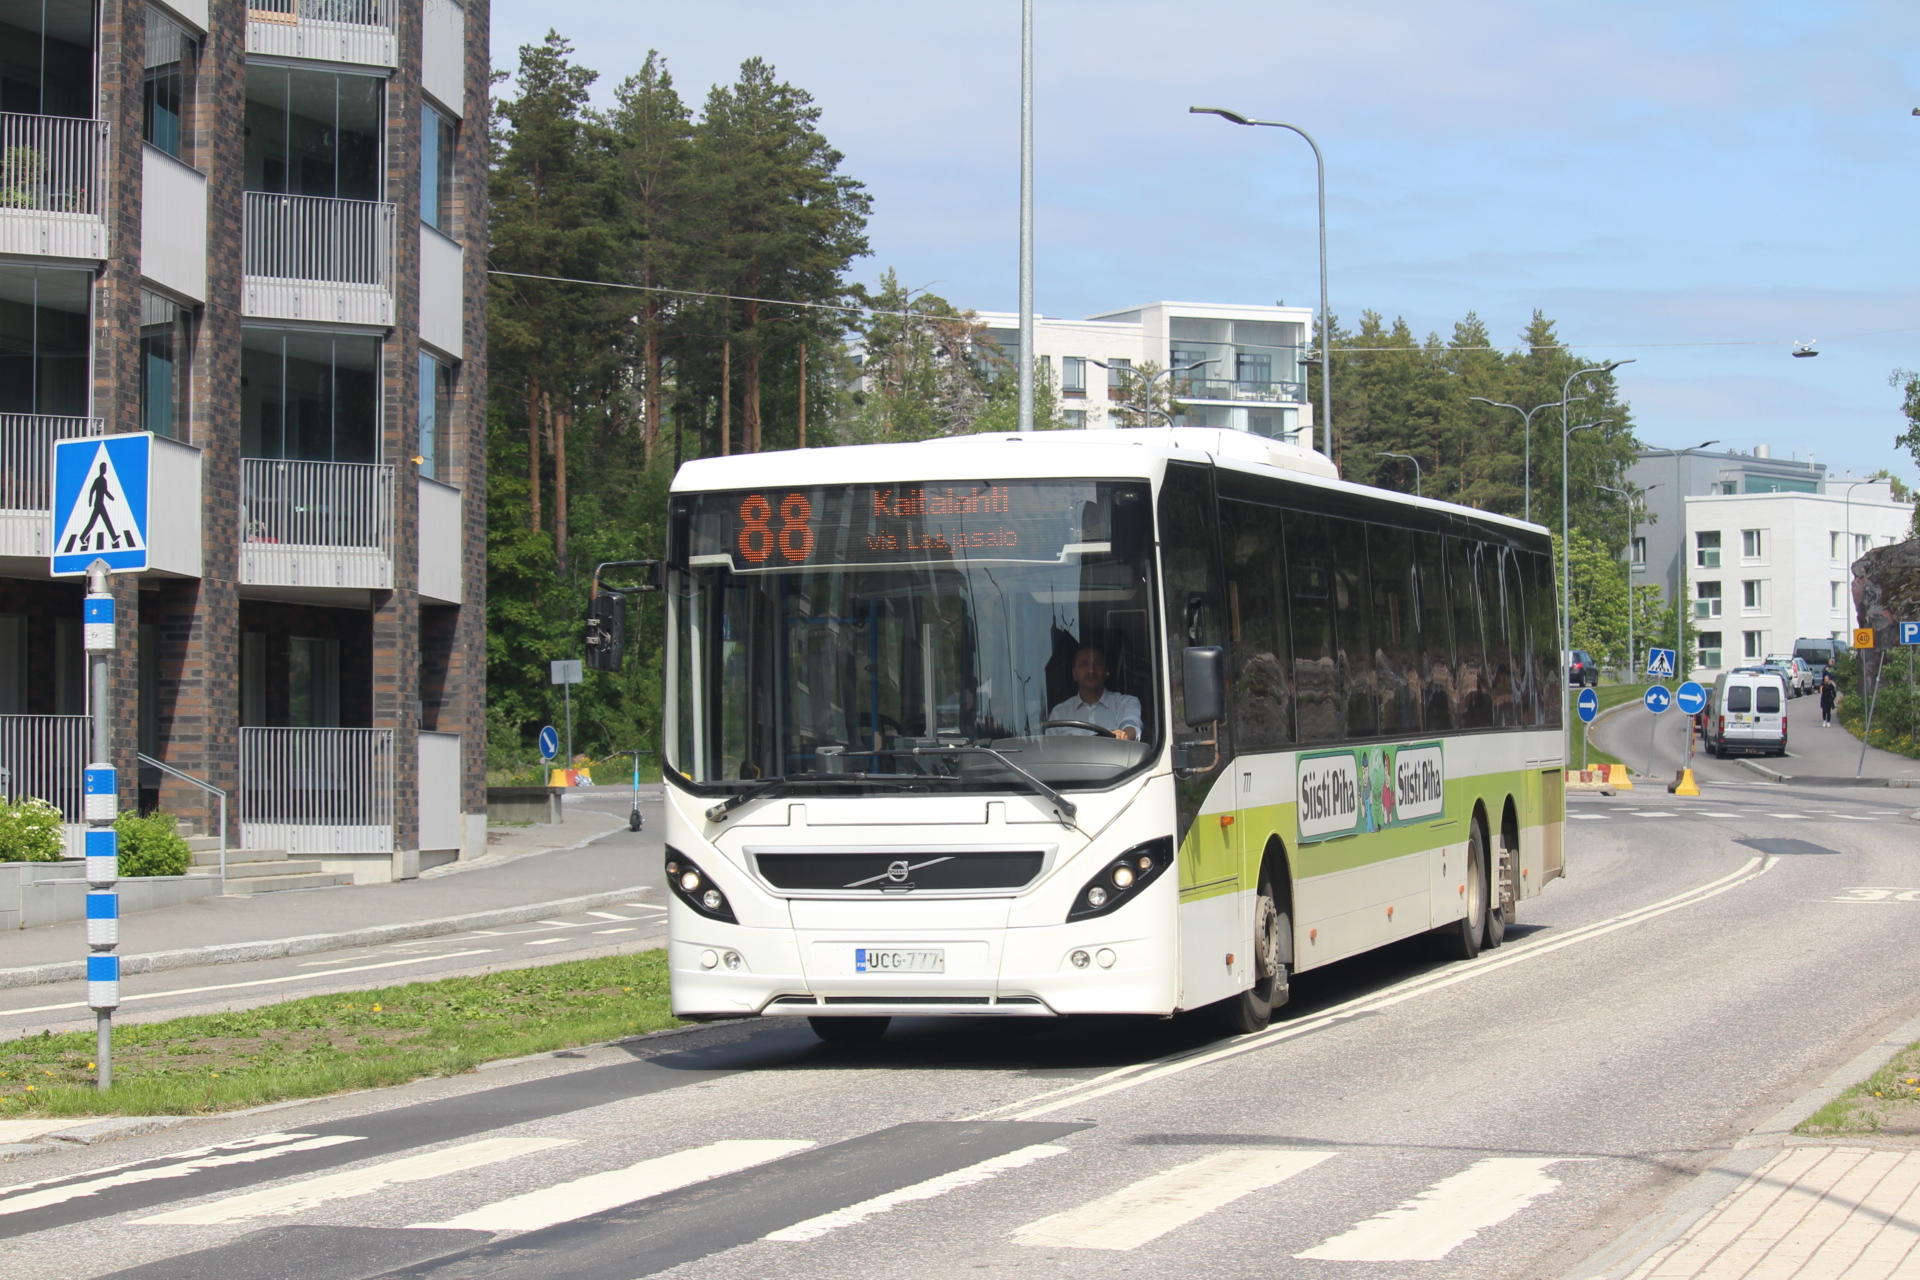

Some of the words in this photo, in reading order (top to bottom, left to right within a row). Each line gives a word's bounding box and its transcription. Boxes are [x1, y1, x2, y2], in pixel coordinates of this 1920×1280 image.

[874, 486, 1009, 516] Kaitalahti
[738, 493, 814, 562] 88
[867, 529, 899, 550] via
[908, 526, 1018, 554] Laajasalo
[1859, 634, 1868, 642] 40
[1904, 623, 1919, 643] P
[1243, 772, 1252, 793] 777
[1302, 769, 1331, 822] Siisti
[1332, 767, 1356, 816] Piha
[1397, 760, 1421, 808] Siisti
[1422, 760, 1441, 802] Piha
[869, 952, 940, 969] UCG-777
